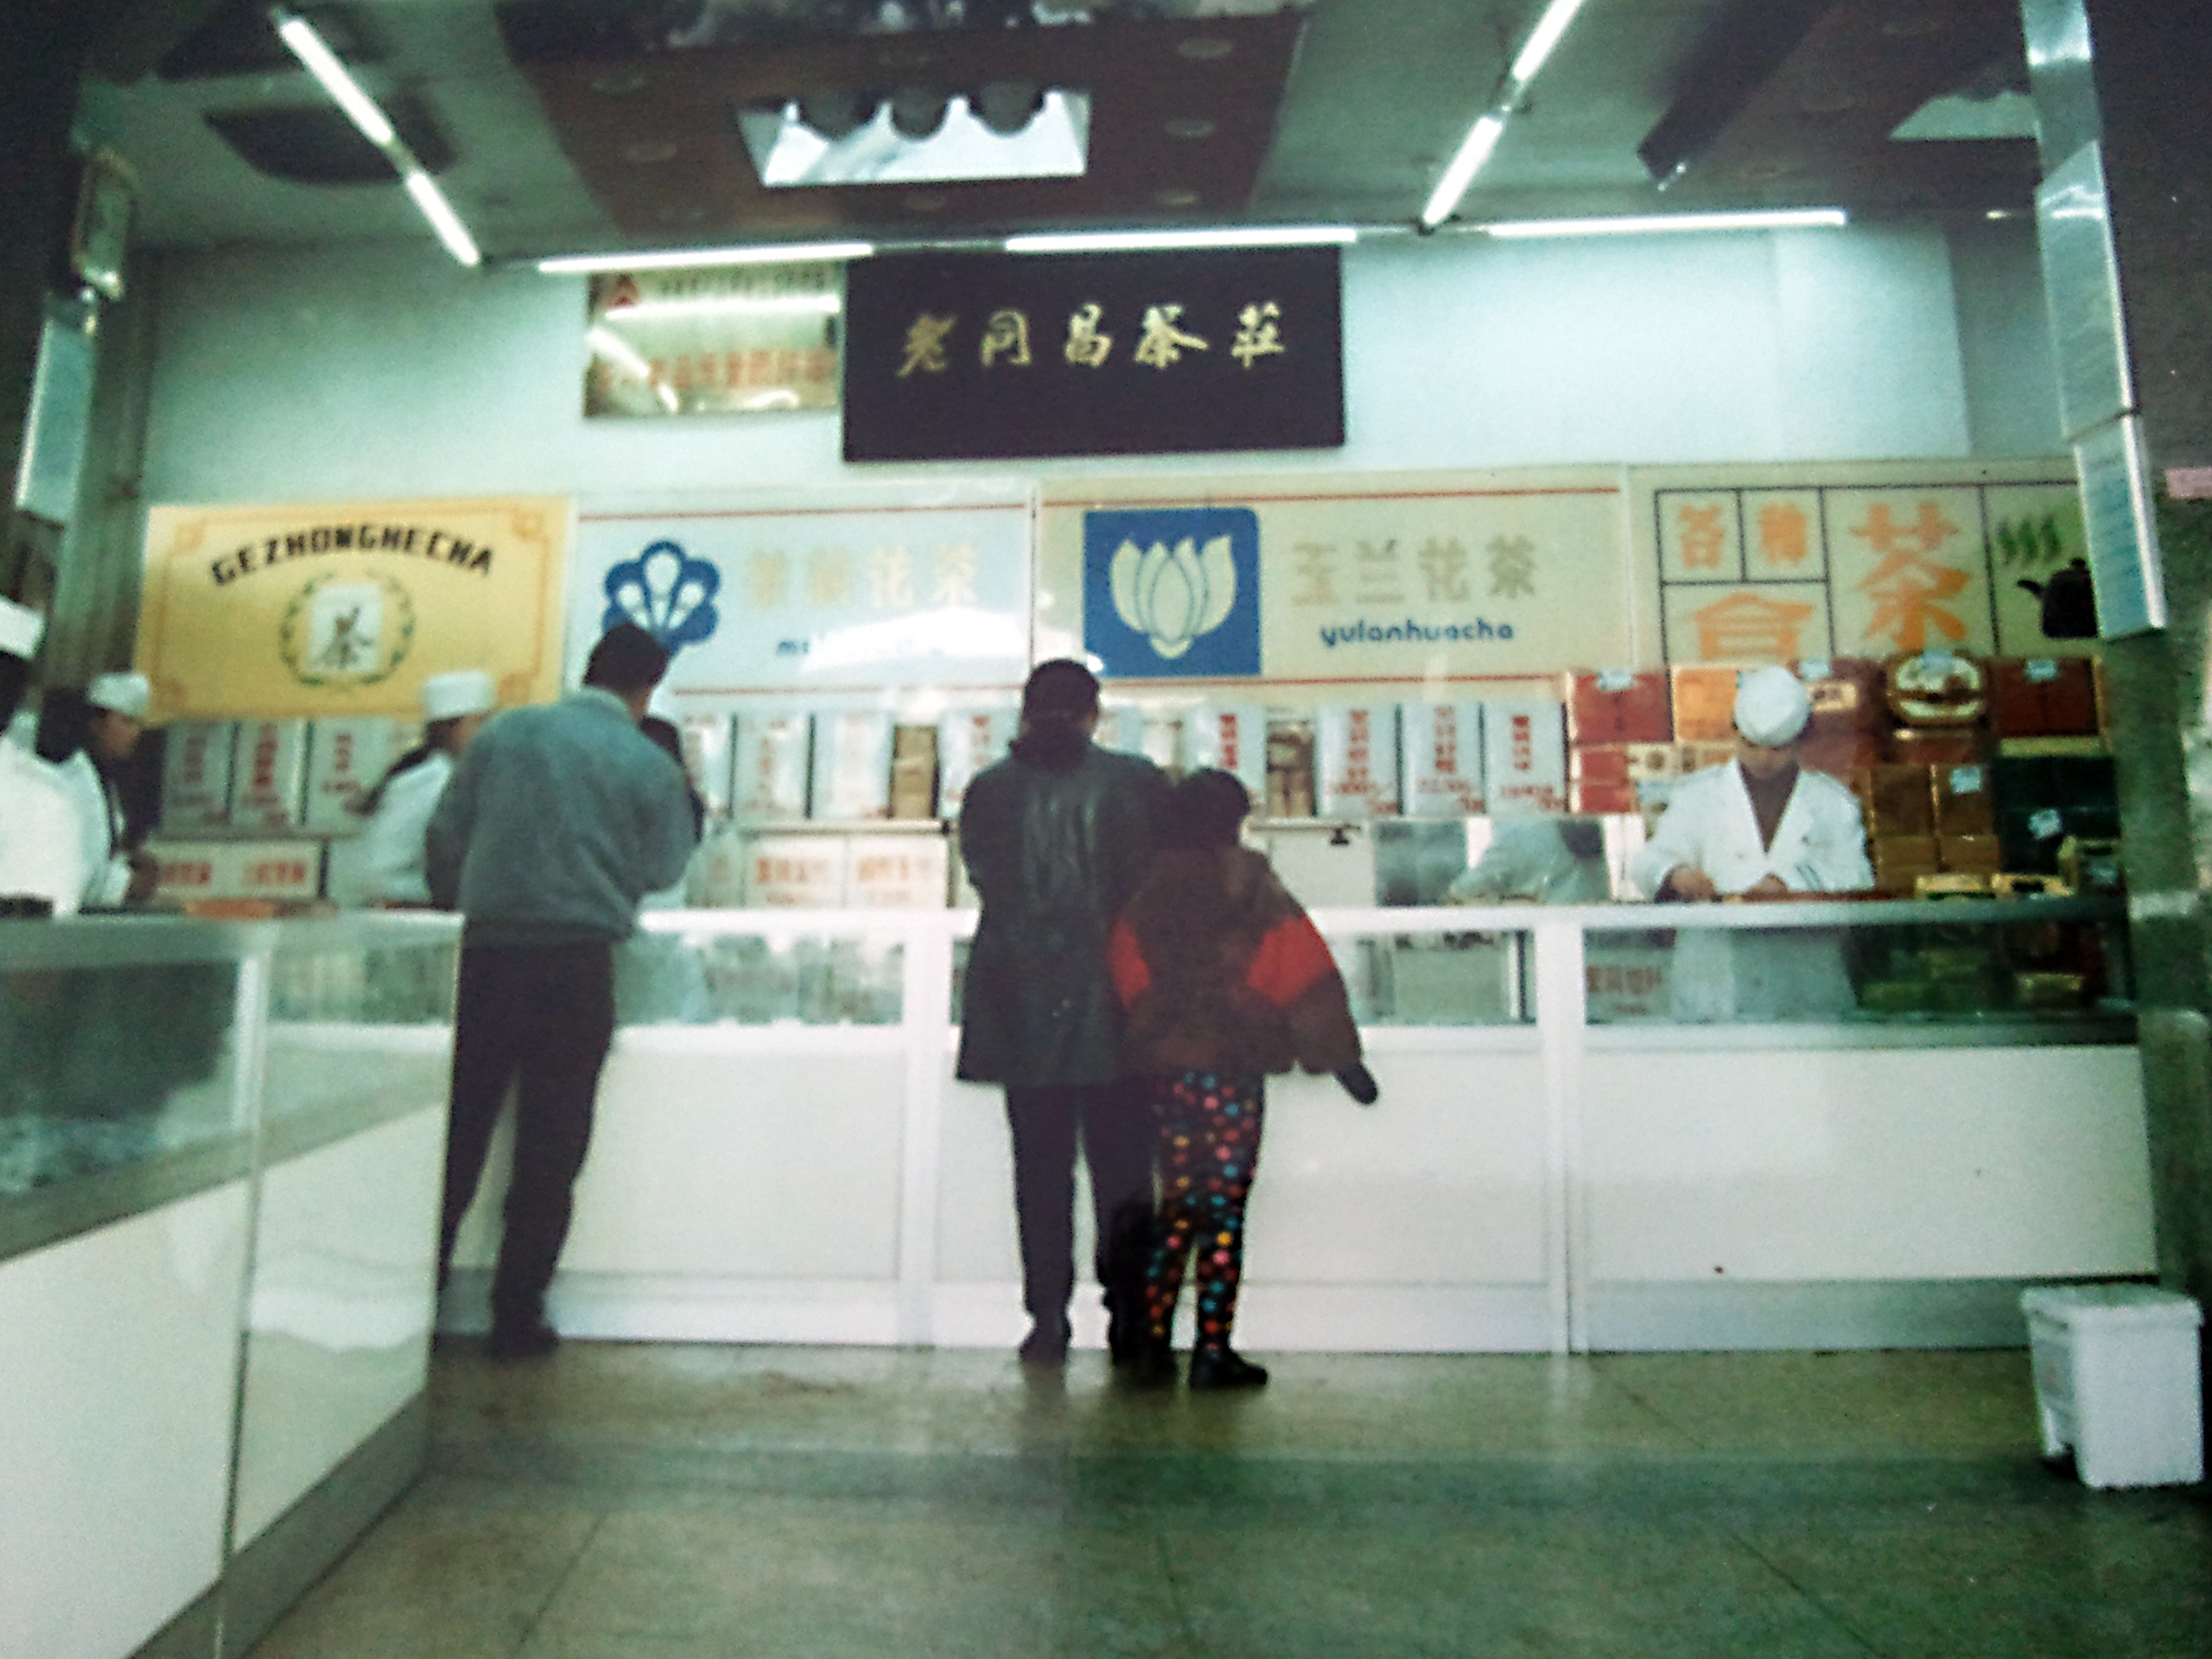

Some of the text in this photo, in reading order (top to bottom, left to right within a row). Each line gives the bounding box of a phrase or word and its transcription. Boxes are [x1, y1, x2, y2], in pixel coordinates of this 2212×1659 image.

[211, 524, 494, 588] GEZHONGHECHA
[1291, 533, 1538, 605] 玉兰花茶
[1849, 499, 1970, 652] 茶
[1320, 617, 1514, 649] yulanhuacha
